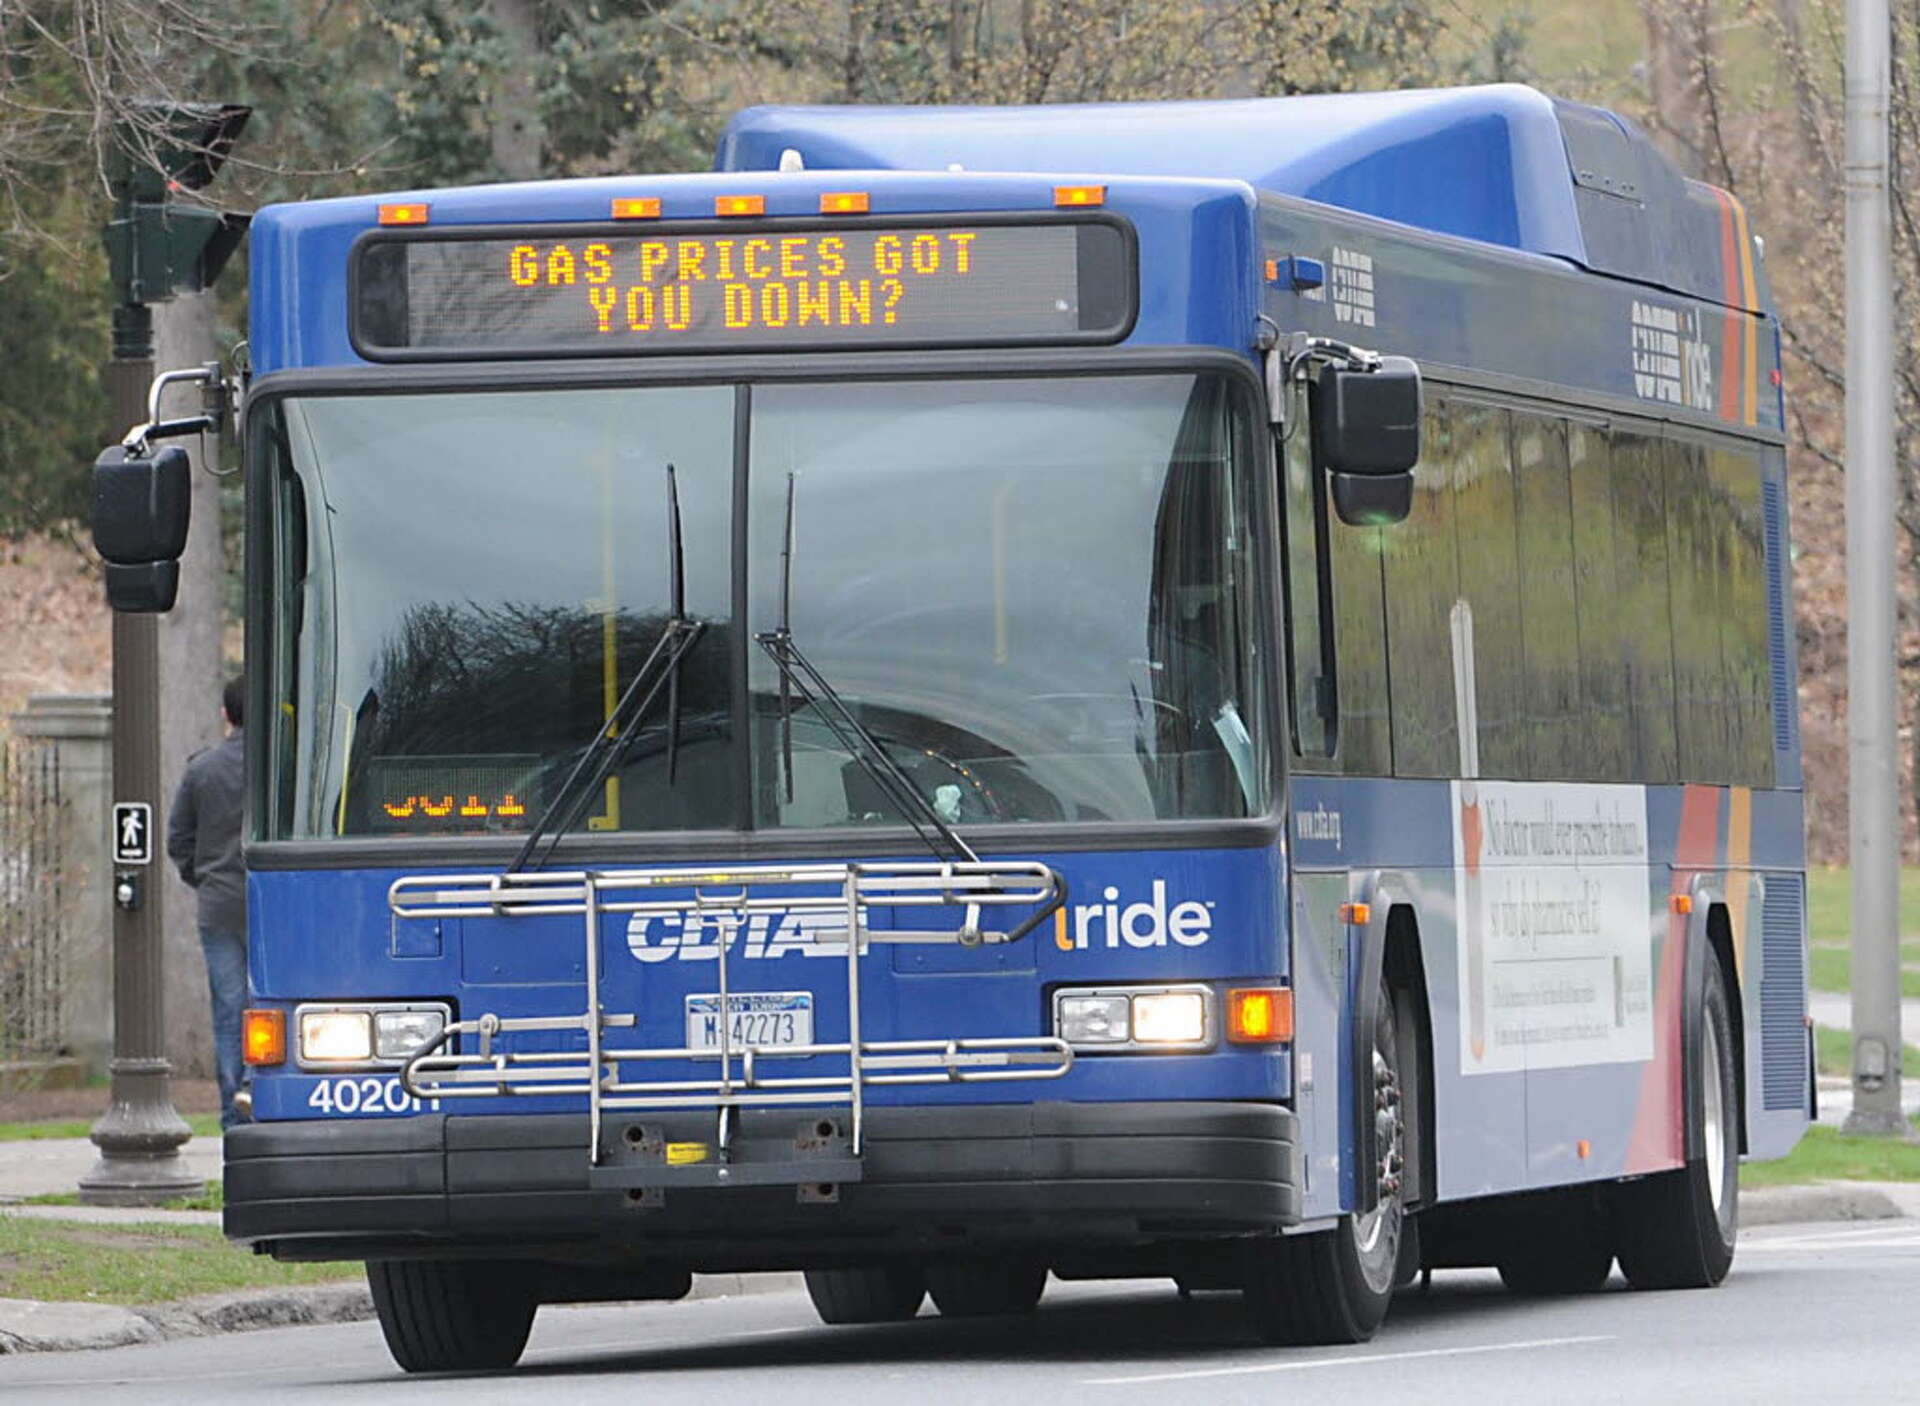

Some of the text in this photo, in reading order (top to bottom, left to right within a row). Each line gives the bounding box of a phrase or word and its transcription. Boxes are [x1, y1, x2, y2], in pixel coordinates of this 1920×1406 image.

[510, 232, 976, 287] GAS PRICES GOT
[588, 278, 905, 332] YOU DOWN?
